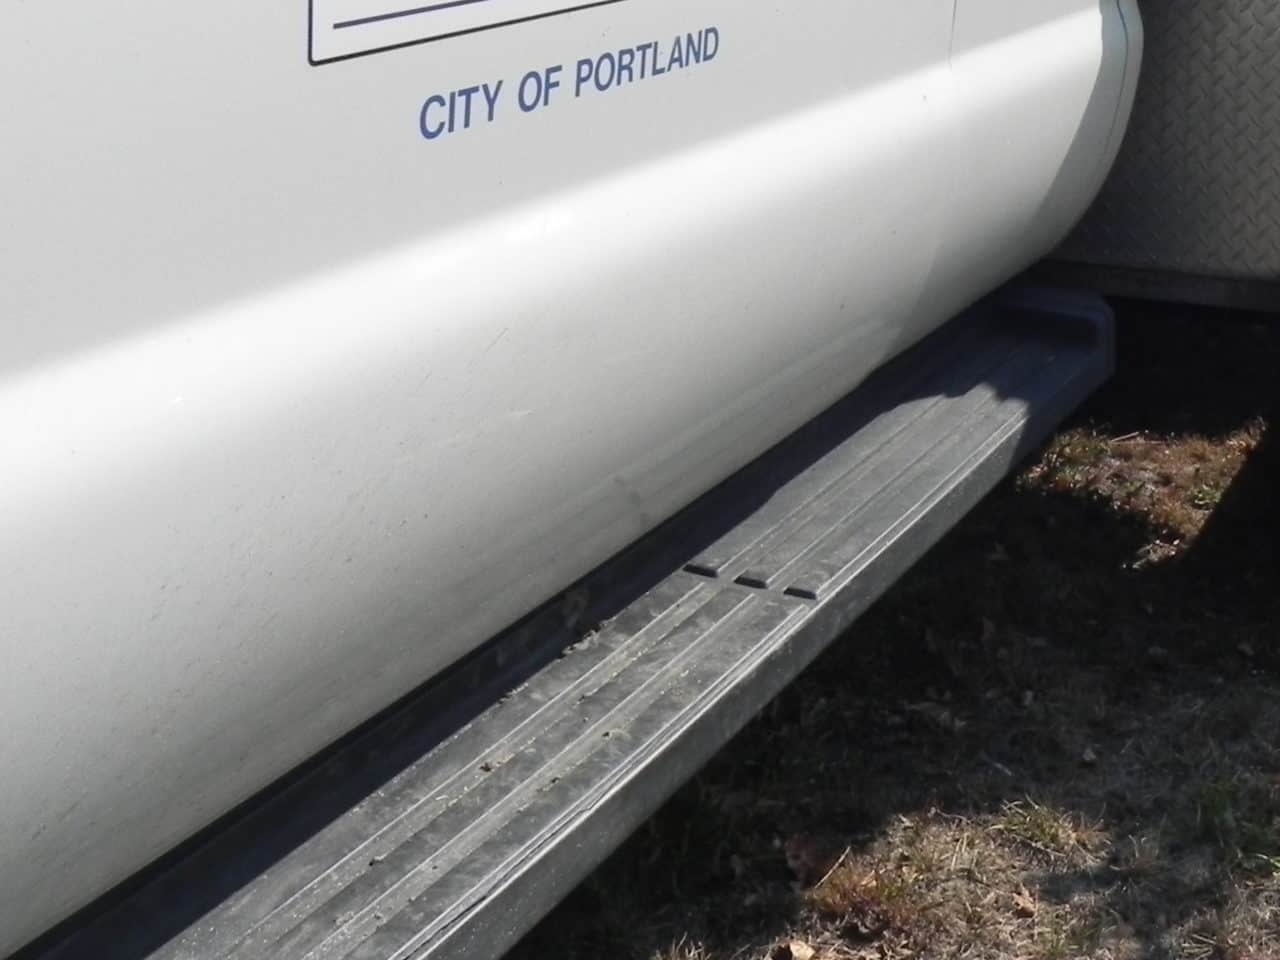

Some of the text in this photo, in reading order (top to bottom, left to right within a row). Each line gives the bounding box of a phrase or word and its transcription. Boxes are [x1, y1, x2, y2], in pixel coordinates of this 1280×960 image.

[418, 26, 720, 140] CITY OF PORTLAND
